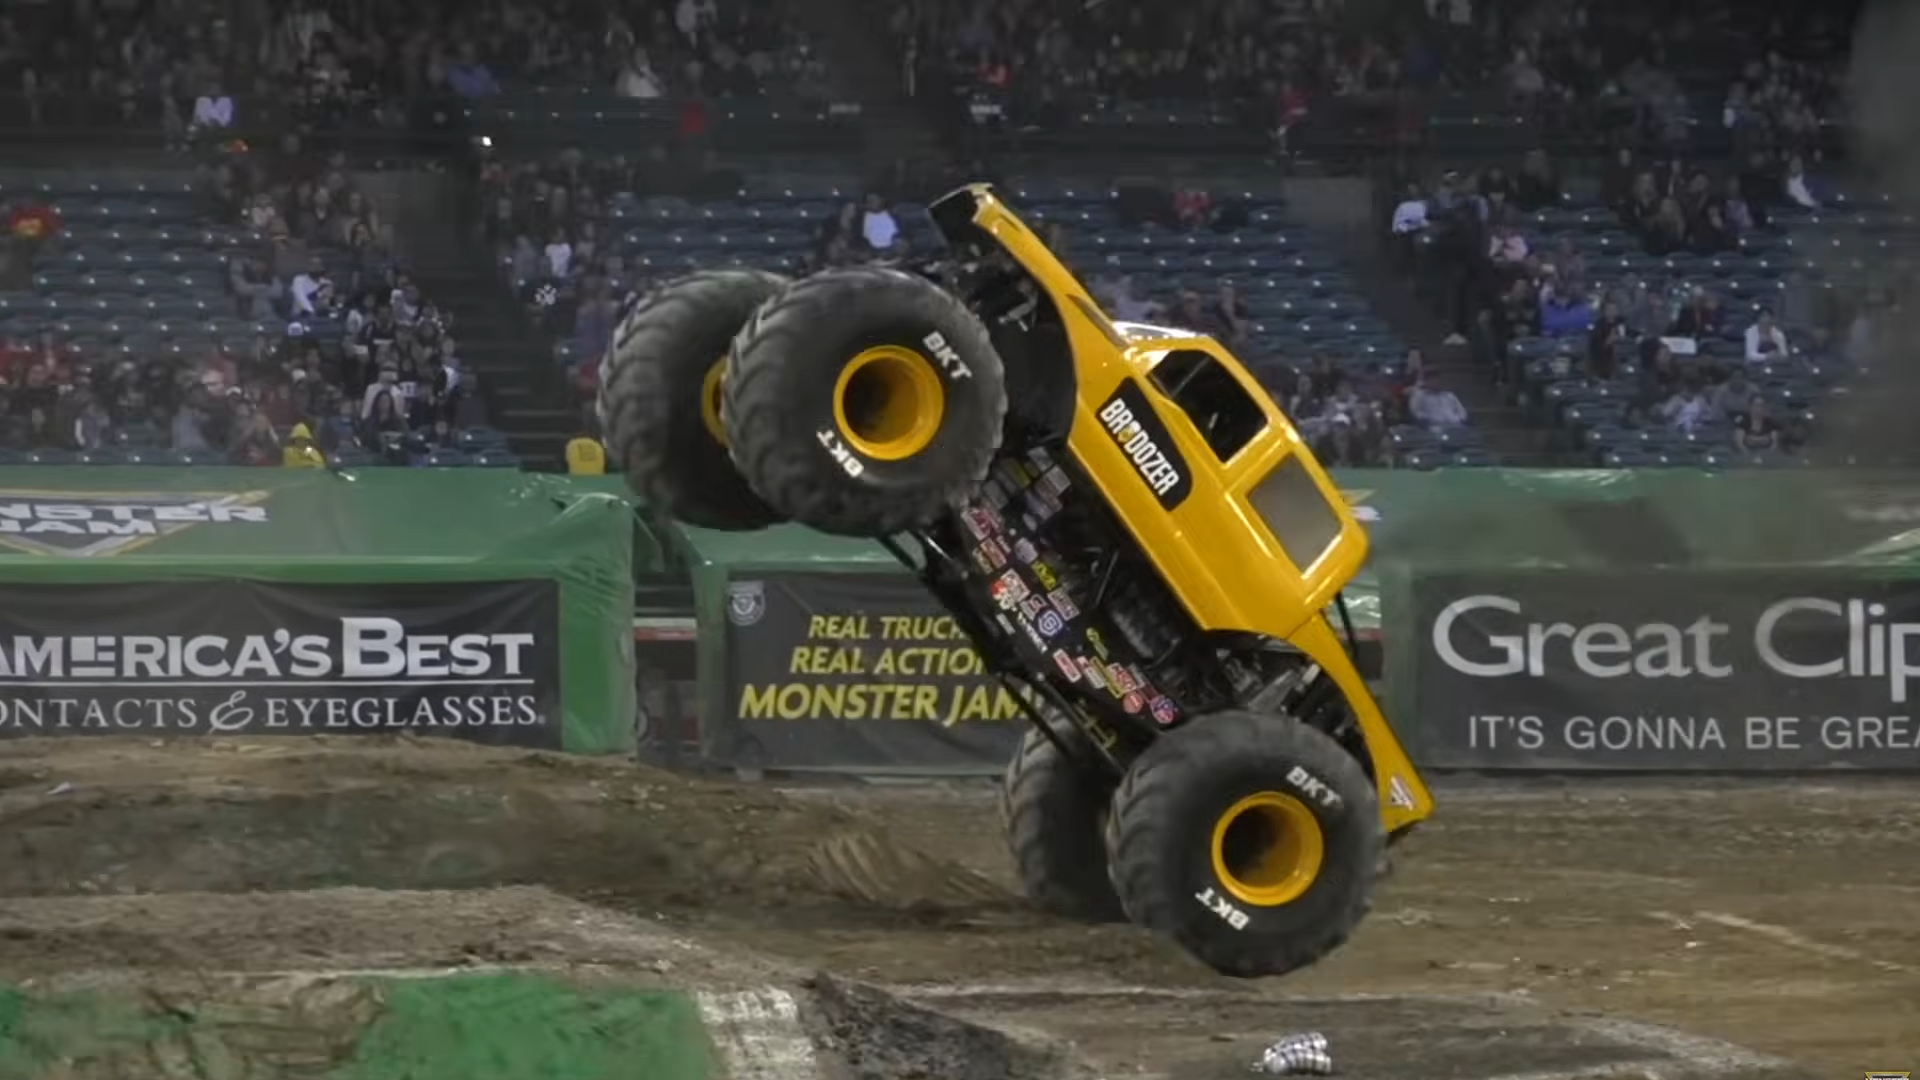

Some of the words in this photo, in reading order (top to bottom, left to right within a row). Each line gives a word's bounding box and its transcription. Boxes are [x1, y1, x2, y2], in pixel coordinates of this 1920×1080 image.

[923, 331, 971, 379] BKT
[816, 430, 865, 478] BKT
[1099, 397, 1178, 496] BRODOZER
[808, 615, 870, 639] REAL
[1432, 595, 1732, 678] Great
[790, 647, 864, 675] REAL
[209, 690, 255, 733] &
[266, 696, 536, 727] EYEGLASSES
[738, 683, 938, 720] MONSTER
[1468, 715, 1544, 749] IT'S
[1564, 715, 1726, 749] GONNA
[1745, 715, 1801, 748] BE
[1820, 715, 1920, 749] GRE
[1286, 766, 1342, 806] BKT
[1195, 886, 1250, 931] BKT
